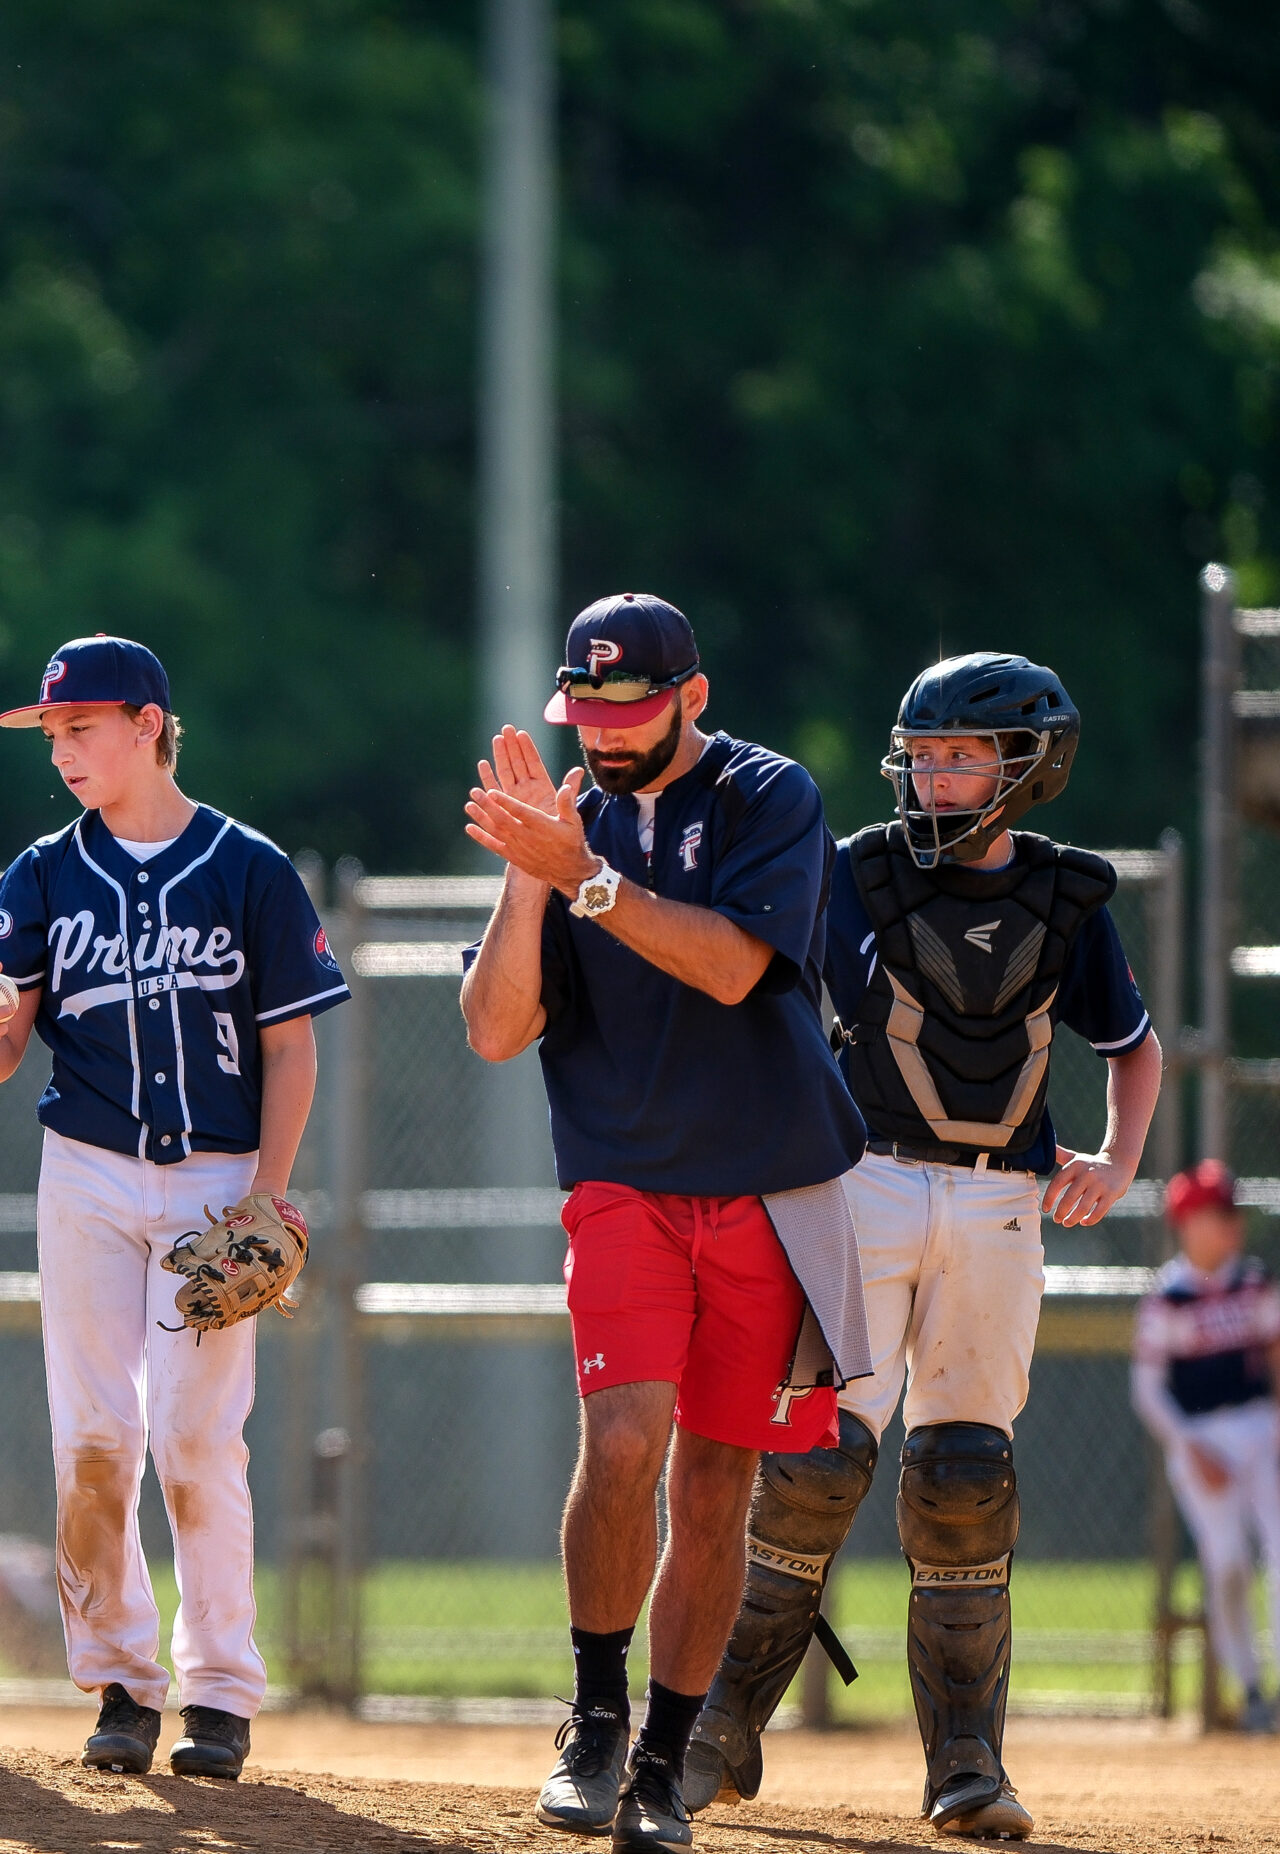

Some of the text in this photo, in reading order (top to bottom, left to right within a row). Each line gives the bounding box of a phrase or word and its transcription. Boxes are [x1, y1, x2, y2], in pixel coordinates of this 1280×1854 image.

[586, 639, 623, 677] P
[41, 660, 67, 703] P
[48, 910, 245, 993] Prime
[139, 974, 179, 996] USA
[212, 1011, 241, 1076] 9
[746, 1544, 821, 1575] ASTON
[916, 1567, 1004, 1582] EASTON
